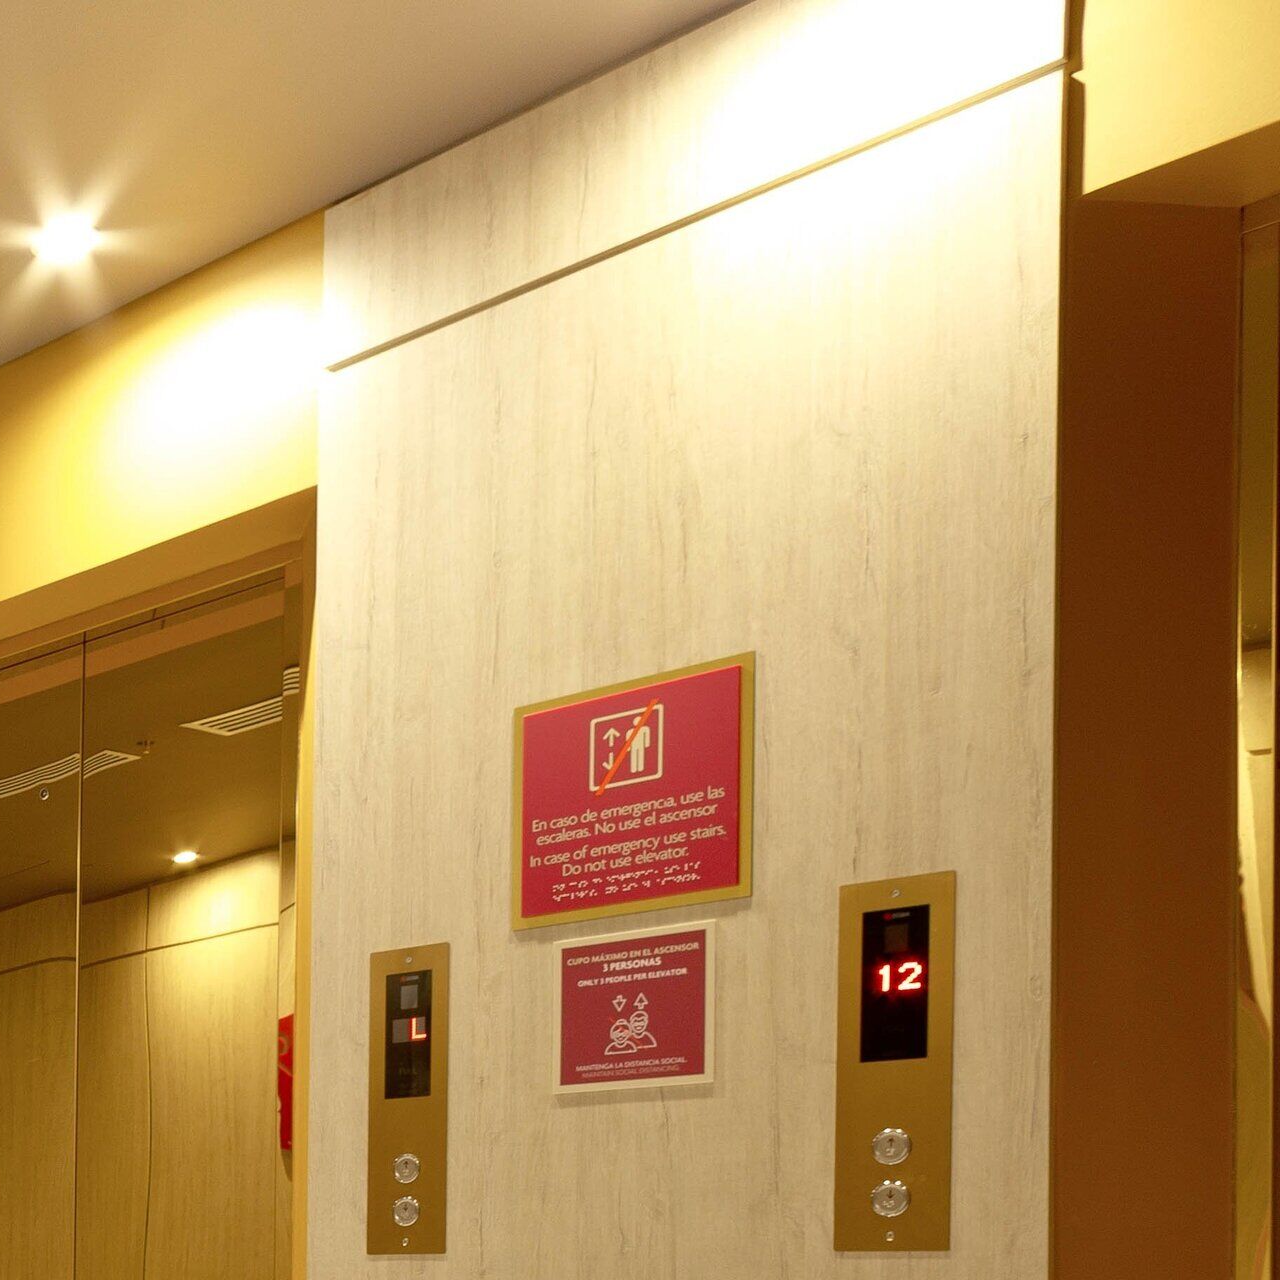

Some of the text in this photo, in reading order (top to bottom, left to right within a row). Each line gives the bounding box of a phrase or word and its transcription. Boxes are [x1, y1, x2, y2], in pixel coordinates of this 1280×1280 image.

[532, 819, 547, 832] En
[550, 815, 578, 829] caso
[581, 808, 598, 823] de
[680, 791, 704, 804] use
[707, 785, 725, 799] las
[536, 804, 718, 845] escaleras. No use el ascensor
[530, 824, 727, 867] In case of emergency use stairs.
[562, 846, 689, 877] Do not use elevator.
[567, 942, 699, 966] CUPO MÁXIMO EN EL ASCENSOR
[602, 957, 662, 972] 3 PERSONAS
[577, 978, 599, 987] ONLY
[605, 974, 632, 984] PEOPLE
[633, 972, 647, 980] PER
[647, 967, 688, 979] ELEVATOR
[878, 961, 923, 992] 12
[411, 1017, 427, 1040] L
[575, 1062, 614, 1072] MANTENGA
[615, 1061, 624, 1069] LA
[624, 1058, 660, 1068] DISTANCIA
